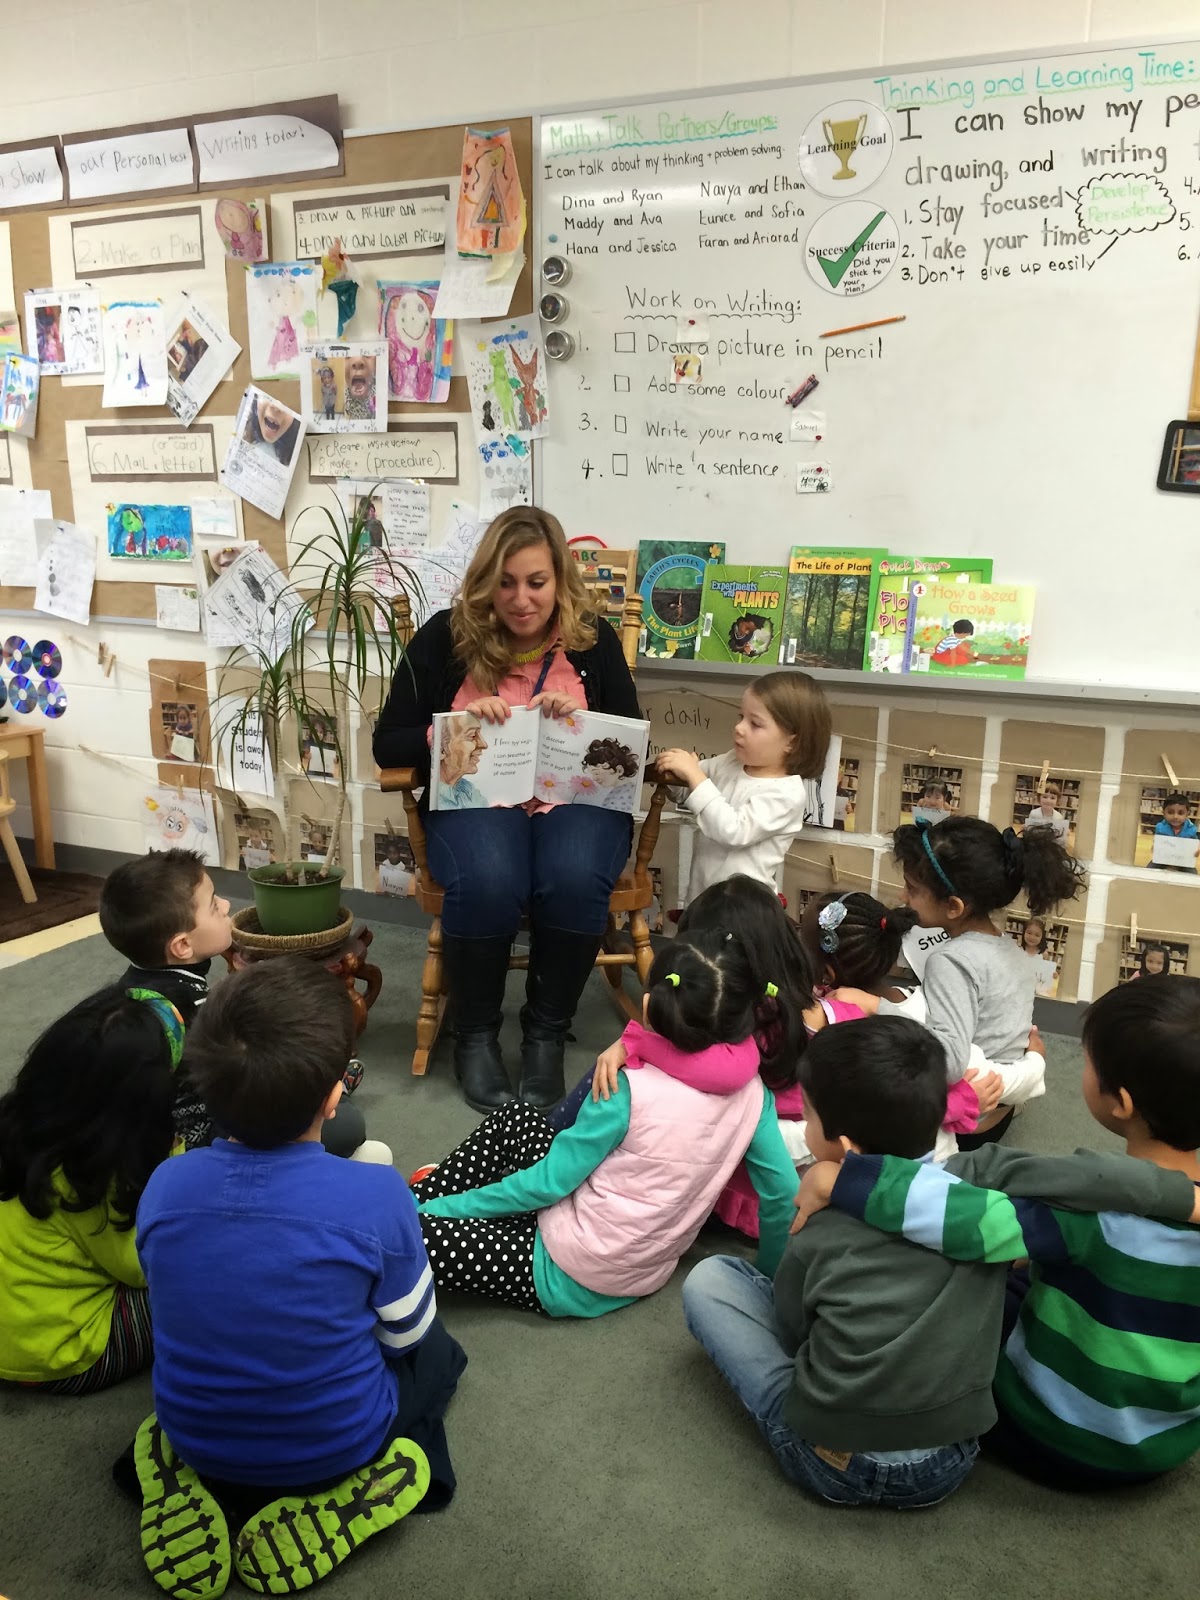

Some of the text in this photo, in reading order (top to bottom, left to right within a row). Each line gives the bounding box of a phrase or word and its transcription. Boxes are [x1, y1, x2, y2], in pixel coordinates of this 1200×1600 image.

[873, 51, 1195, 108] Thinking and Learning Time:
[896, 106, 923, 141] I
[954, 112, 1004, 134] can
[1023, 96, 1085, 126] show
[1106, 99, 1143, 133] my
[550, 125, 592, 150] Math
[602, 114, 644, 141] Talk
[807, 133, 887, 155] Learning Goal
[80, 152, 106, 174] our
[544, 165, 553, 180] I
[556, 168, 576, 179] can
[578, 158, 604, 177] talk
[611, 155, 640, 172] about
[645, 158, 660, 175] my
[662, 149, 704, 168] thinking
[714, 145, 749, 163] problem
[904, 155, 1009, 193] drawing,
[1019, 150, 1054, 173] and
[1081, 137, 1168, 173] writing
[561, 188, 663, 211] Dina and Ryan
[700, 175, 806, 205] Navya and Ethan
[1091, 182, 1150, 201] Develop
[310, 210, 339, 224] Draw
[400, 203, 416, 217] and
[699, 201, 805, 226] Eunice and Sofia
[919, 196, 964, 235] Stay
[980, 186, 1064, 218] focused
[564, 212, 663, 236] Maddy and Ava
[352, 234, 376, 248] and
[566, 237, 677, 255] Hana and Jessica
[698, 234, 730, 248] Faran
[733, 232, 750, 246] and
[808, 238, 896, 258] Success Criteria
[901, 217, 1091, 266] 2. Take your time
[853, 256, 891, 268] Did you
[1177, 244, 1191, 261] 6.
[849, 268, 882, 278] stick to
[901, 257, 1096, 285] 3. Don't give up easily
[843, 279, 860, 288] your
[845, 283, 866, 296] plan?
[625, 285, 802, 323] Work on Writing:
[647, 334, 692, 355] Draw
[697, 342, 709, 355] a
[717, 329, 786, 366] picture
[795, 339, 813, 357] in
[825, 336, 883, 372] pencil
[688, 382, 726, 397] some
[578, 412, 732, 444] 3. Write your
[581, 458, 603, 480] 4.
[645, 455, 684, 475] Write
[646, 557, 700, 584] EARTH'S CYCLES
[797, 562, 872, 572] The Life of Plant
[711, 580, 758, 592] Experiments
[932, 585, 1018, 602] How a Seed
[733, 590, 780, 609] PLANTS
[948, 601, 996, 616] Grows
[647, 614, 682, 638] The Plant
[664, 702, 710, 730] daily
[235, 743, 244, 752] is
